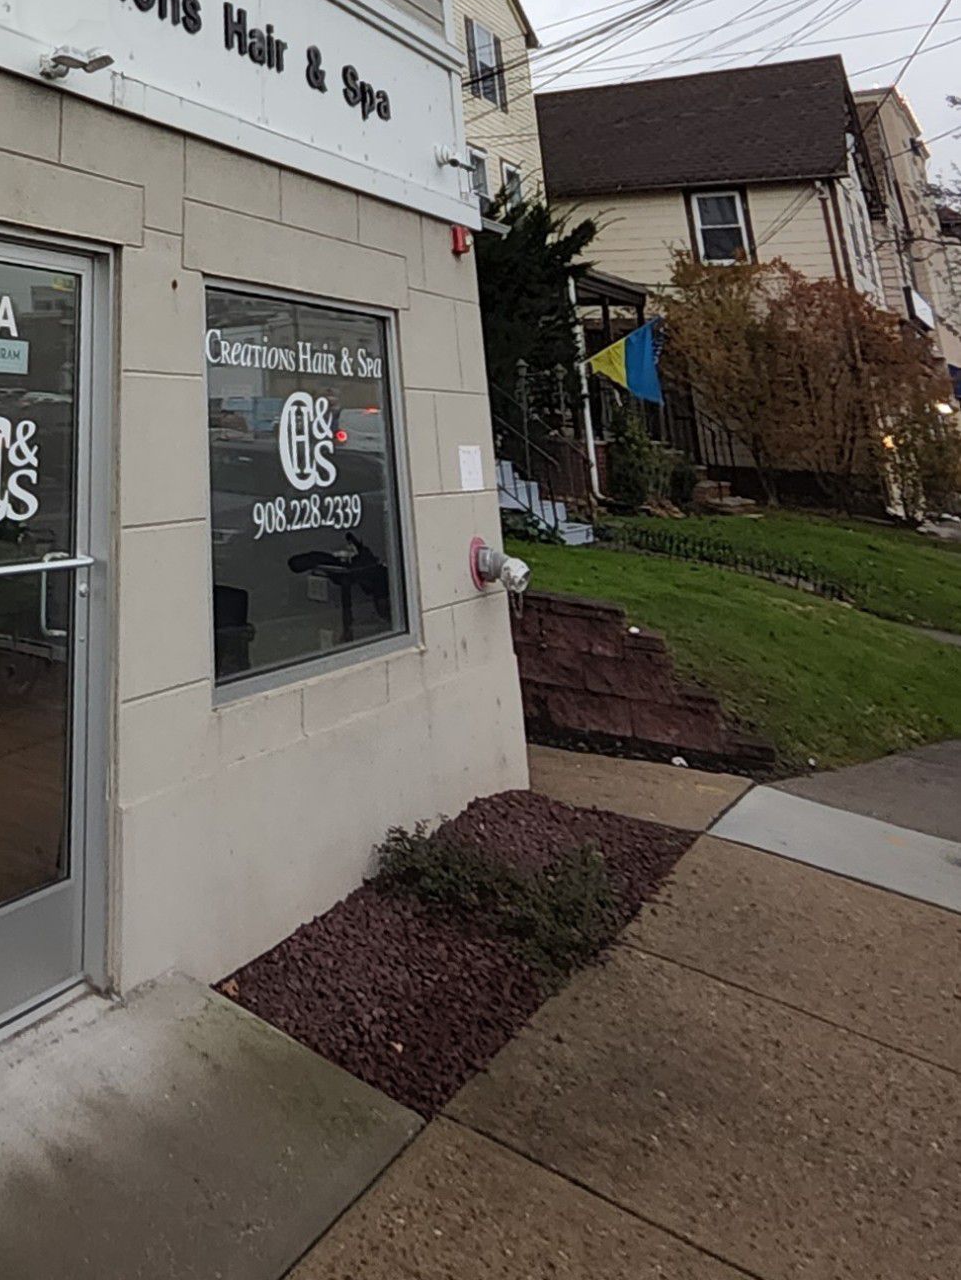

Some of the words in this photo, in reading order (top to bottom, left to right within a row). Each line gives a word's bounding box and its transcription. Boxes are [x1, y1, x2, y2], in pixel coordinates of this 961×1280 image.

[223, 1, 286, 72] Hair
[305, 45, 327, 92] &
[342, 64, 391, 121] Spa
[340, 350, 354, 377] &
[253, 494, 362, 540] 908.228.2339
